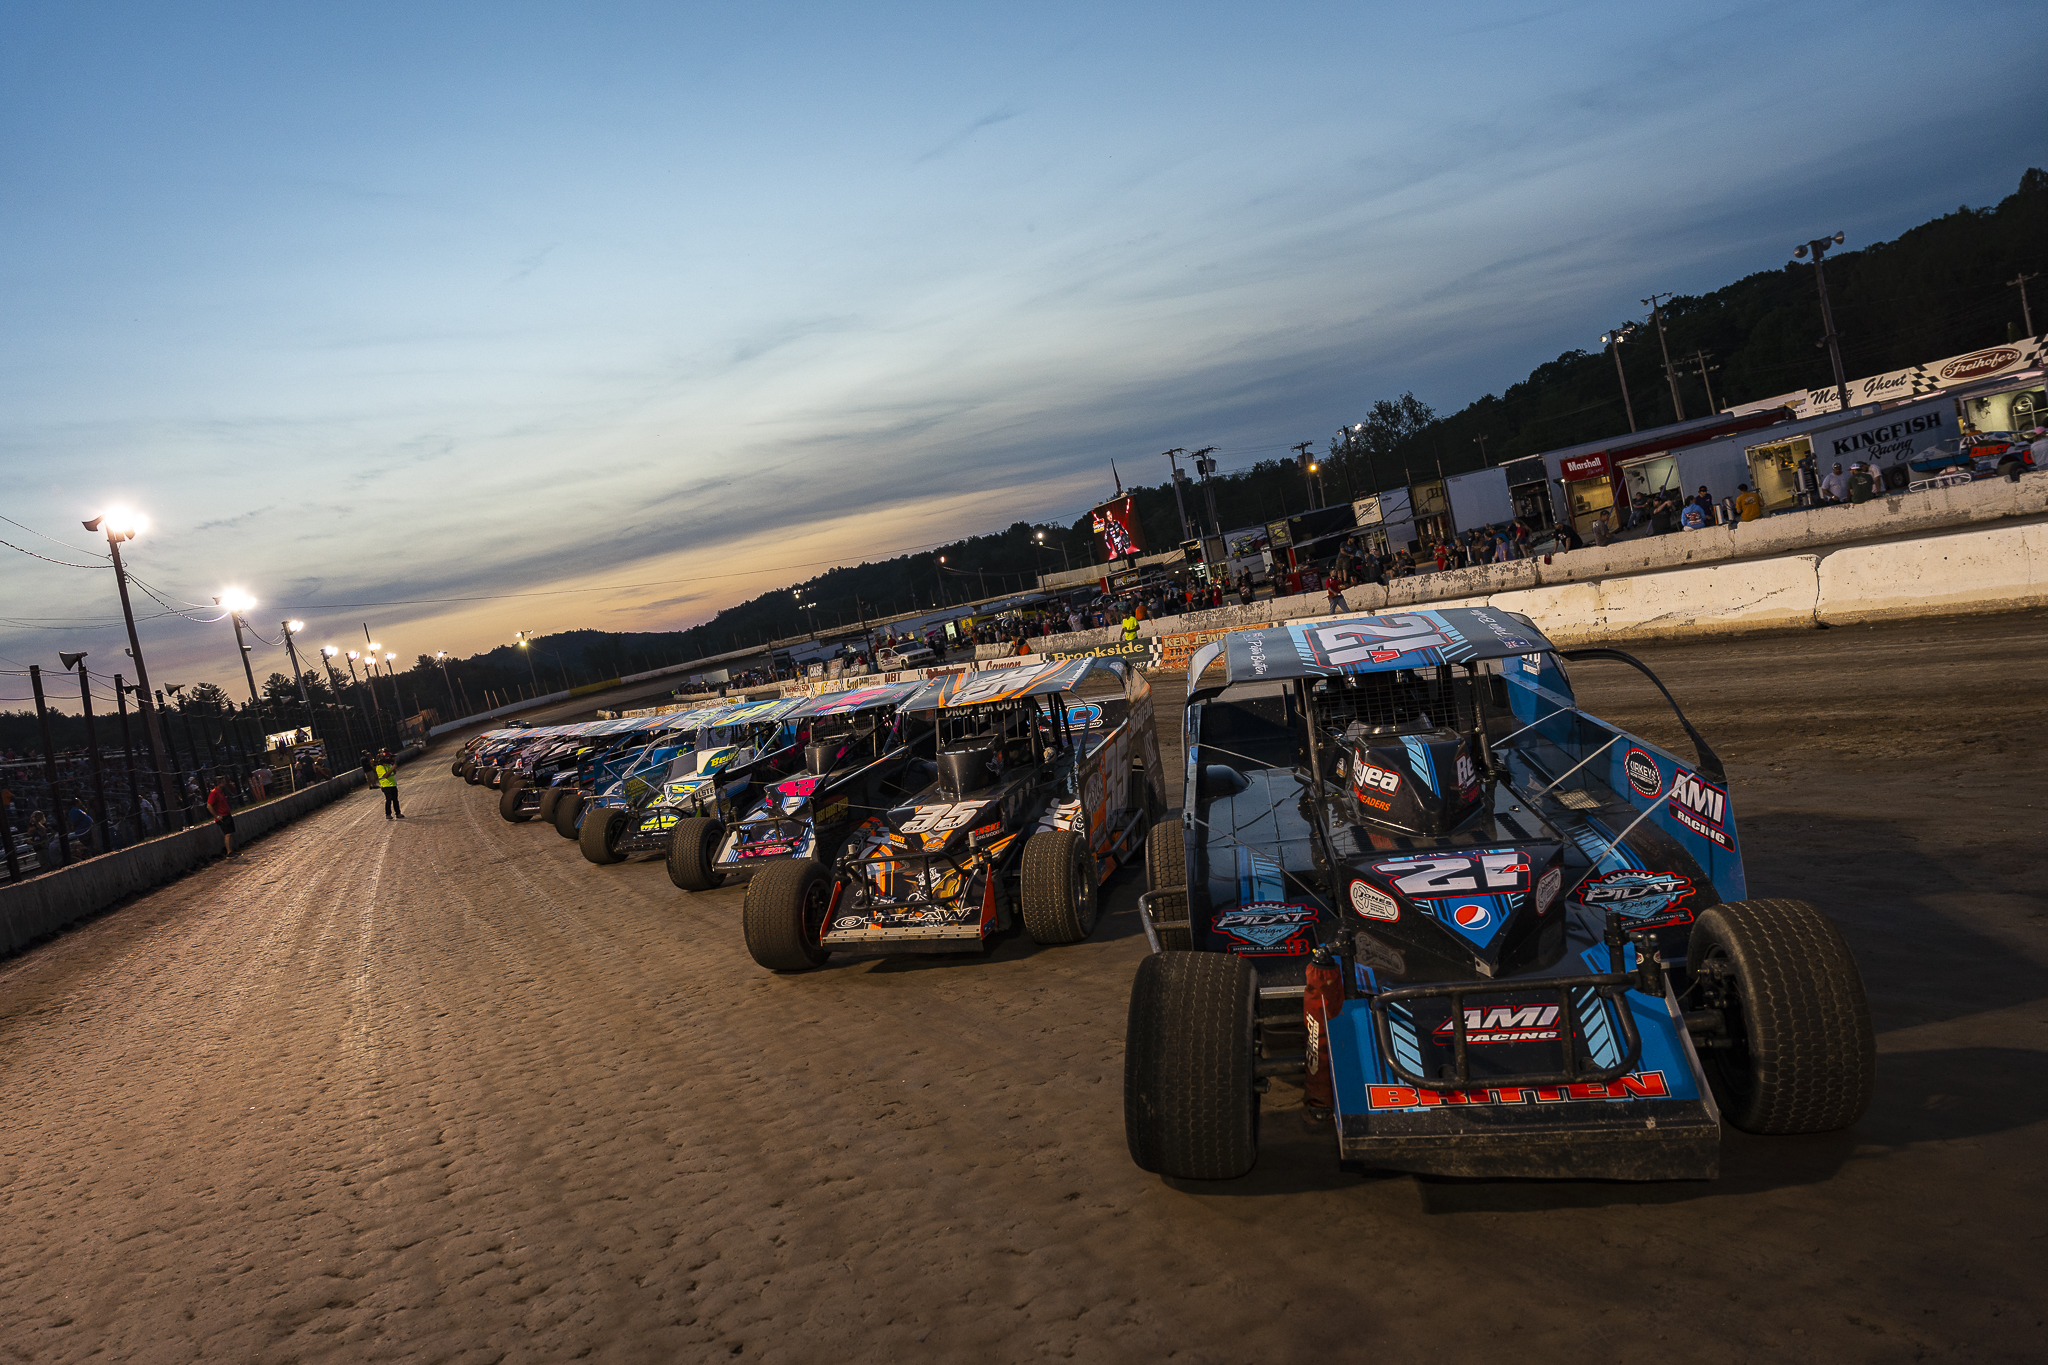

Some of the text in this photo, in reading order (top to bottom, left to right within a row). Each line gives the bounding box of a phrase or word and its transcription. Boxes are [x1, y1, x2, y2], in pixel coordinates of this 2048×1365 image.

[1864, 374, 1908, 398] Ghent
[1832, 411, 1942, 456] KINGFISH
[1868, 437, 1914, 461] Racing
[1969, 443, 2010, 458] DARCY
[1567, 457, 1602, 472] Marshall
[1164, 637, 1189, 648] KEN
[1052, 641, 1144, 662] Brookside
[945, 706, 973, 718] DROP
[996, 701, 1024, 712] OUT!
[1353, 749, 1400, 792] Beyea
[671, 784, 698, 794] 55
[776, 778, 818, 796] 42
[1671, 773, 1724, 823] AMI
[899, 800, 991, 833] 35
[974, 821, 1001, 836] ENSKE
[1677, 810, 1726, 845] RACING
[1359, 891, 1392, 907] JONES
[1585, 880, 1685, 901] PILAT
[1621, 899, 1658, 910] Design
[1216, 912, 1312, 928] PILAT
[1247, 927, 1283, 936] Design
[1441, 1005, 1559, 1031] AMI
[1464, 1031, 1557, 1042] RACING
